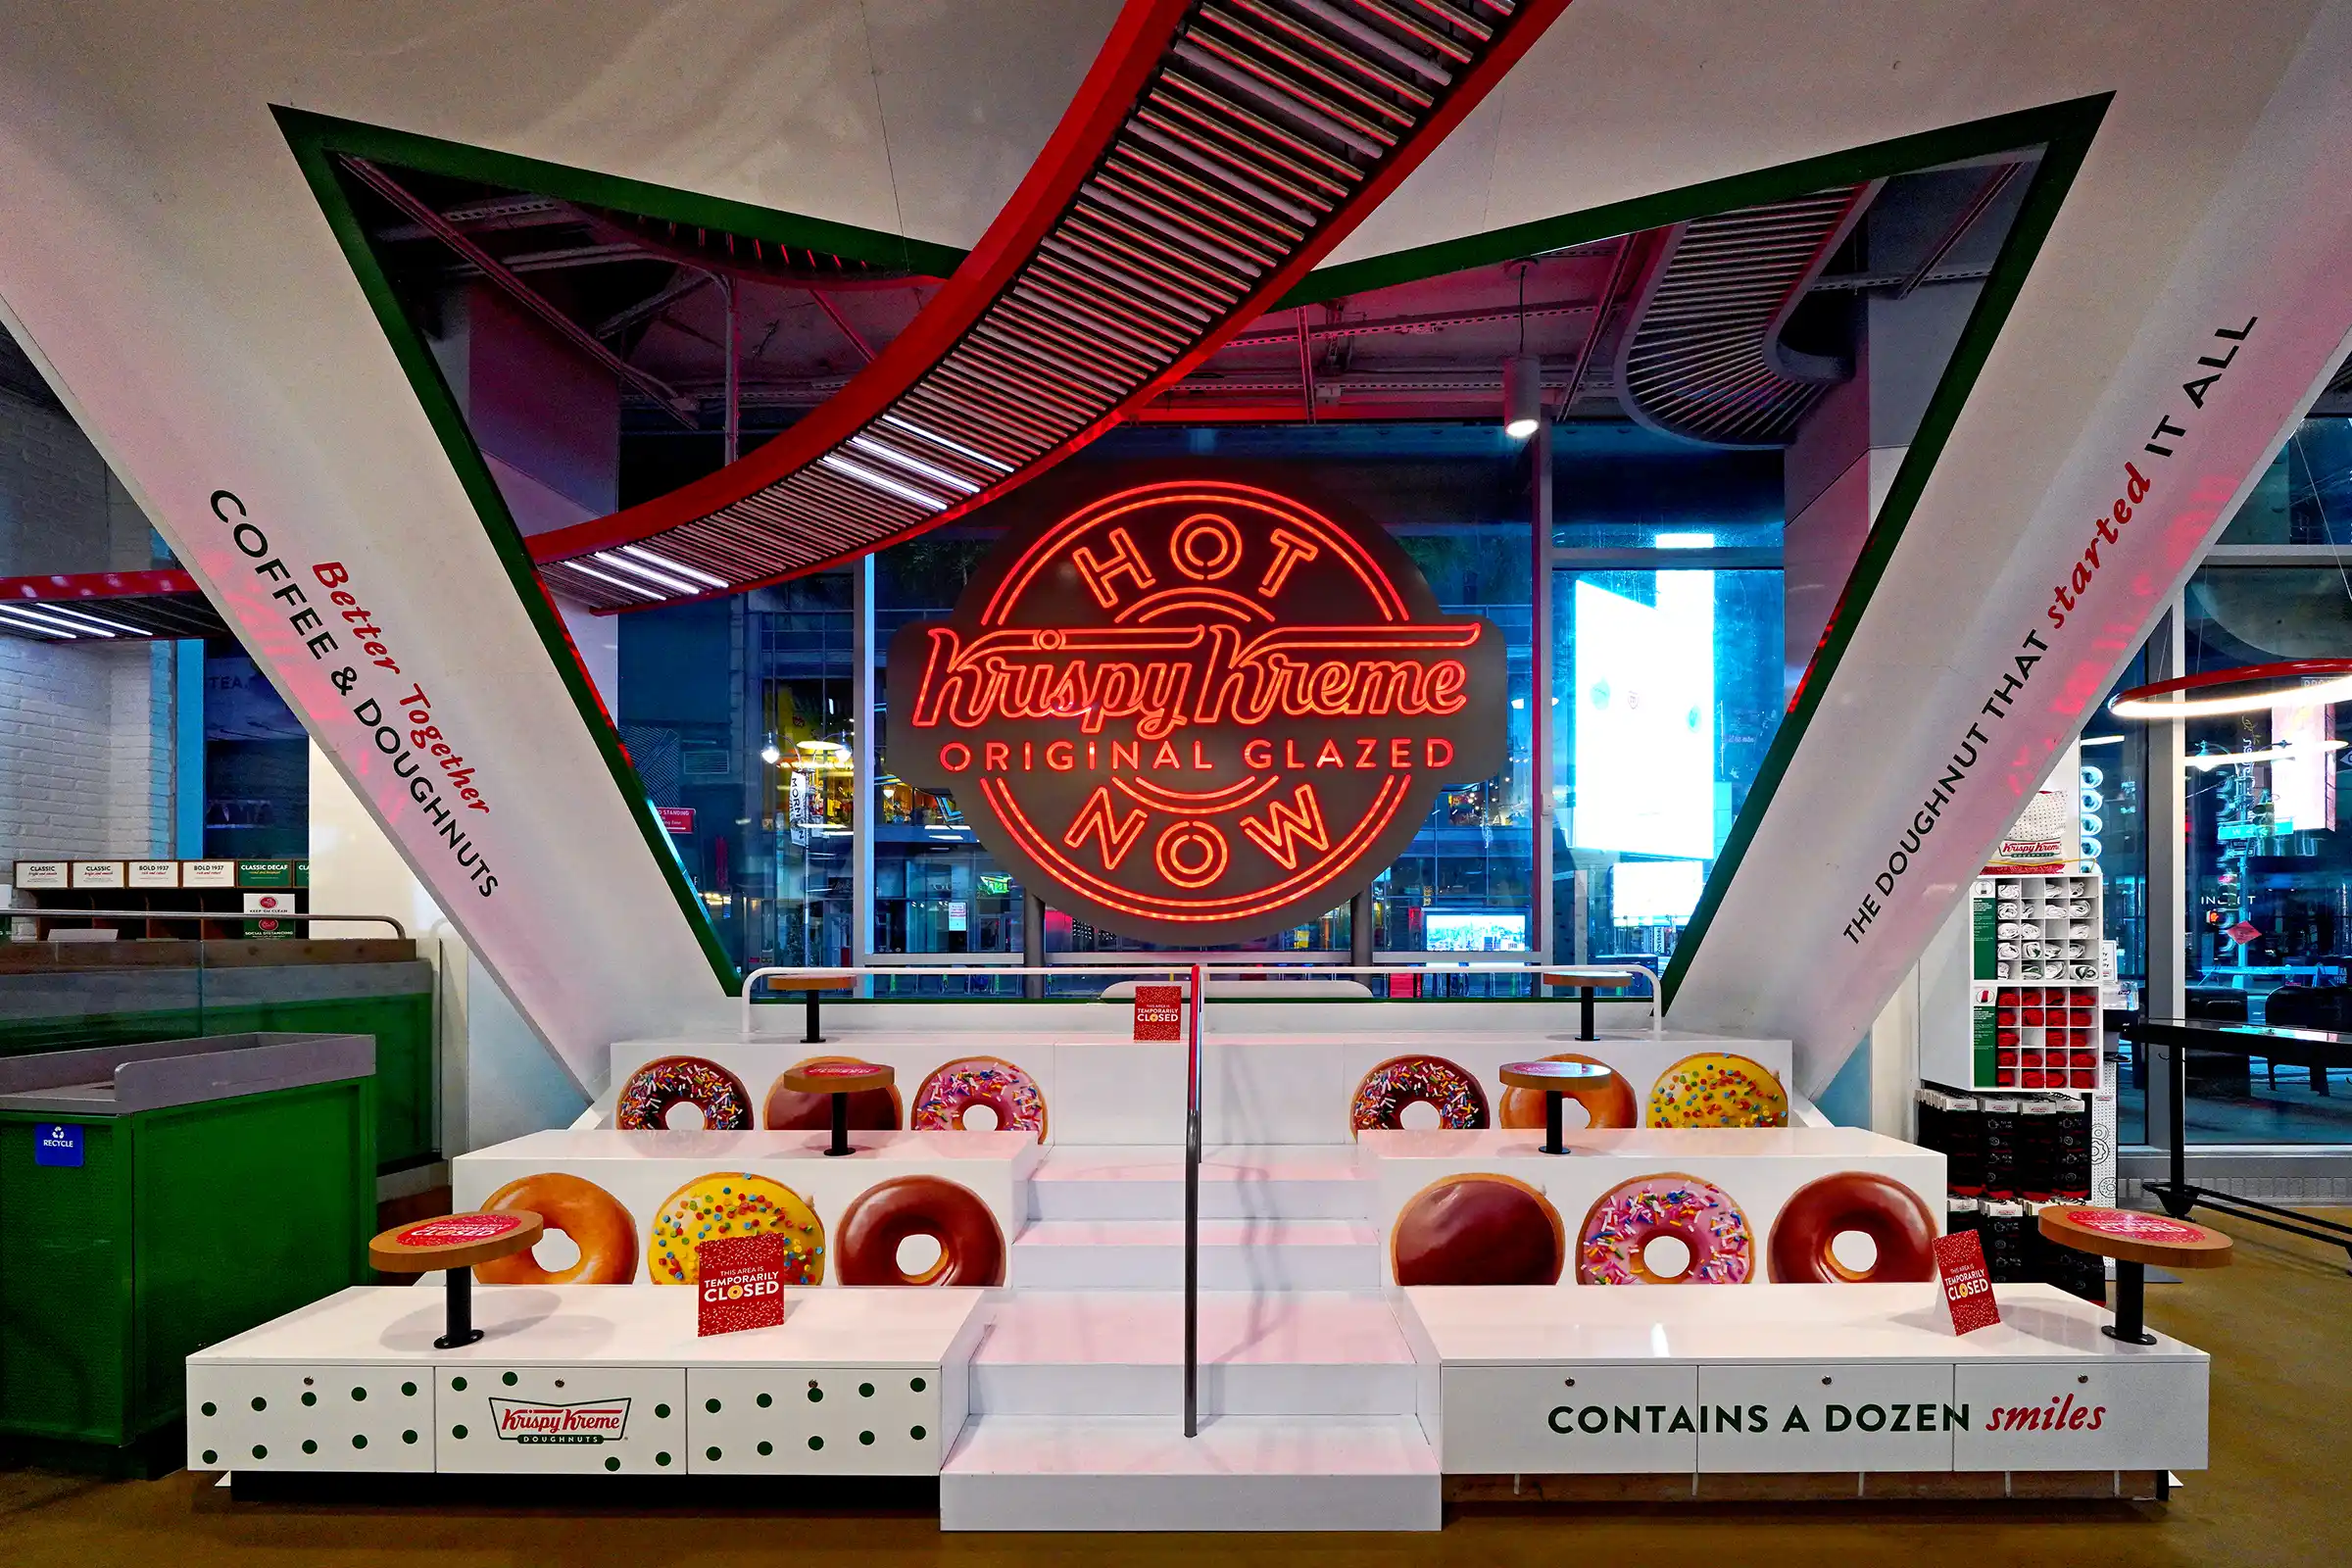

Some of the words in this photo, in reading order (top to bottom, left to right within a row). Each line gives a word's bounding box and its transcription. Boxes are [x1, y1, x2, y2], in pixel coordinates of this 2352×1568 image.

[1072, 513, 1318, 609] HOT
[1842, 893, 1882, 946] THE
[1875, 721, 1989, 897] DOUGHNUT
[1981, 628, 2048, 720] THAT
[2047, 462, 2152, 629] started
[2143, 415, 2186, 458] IT
[2182, 316, 2259, 410] ALL
[210, 489, 339, 661] COFFEE
[331, 666, 358, 697] &
[353, 697, 499, 899] DOUGHNUTS
[312, 561, 401, 676] Better
[398, 682, 491, 814] Together
[911, 624, 1204, 740] Krispy
[1194, 622, 1482, 725] Kreme
[939, 740, 1215, 772] ORIGINAL
[1244, 737, 1455, 768] GLAZED
[1063, 784, 1331, 890] NOW
[2002, 842, 2037, 853] Krispy
[1137, 1013, 1179, 1022] CLOSED
[43, 1139, 74, 1148] RECYCLE
[704, 1281, 779, 1302] CLOSED
[705, 1271, 779, 1288] TEMPORARILY
[1944, 1269, 1985, 1286] TEMPORARILY
[1947, 1278, 1988, 1300] CLOSED
[502, 1408, 564, 1434] Krispy
[562, 1408, 623, 1431] Kreme
[1547, 1404, 1769, 1435] CONTAINS
[1782, 1404, 1810, 1433] A
[1825, 1403, 1969, 1433] DOZEN
[1984, 1393, 2105, 1432] smiles
